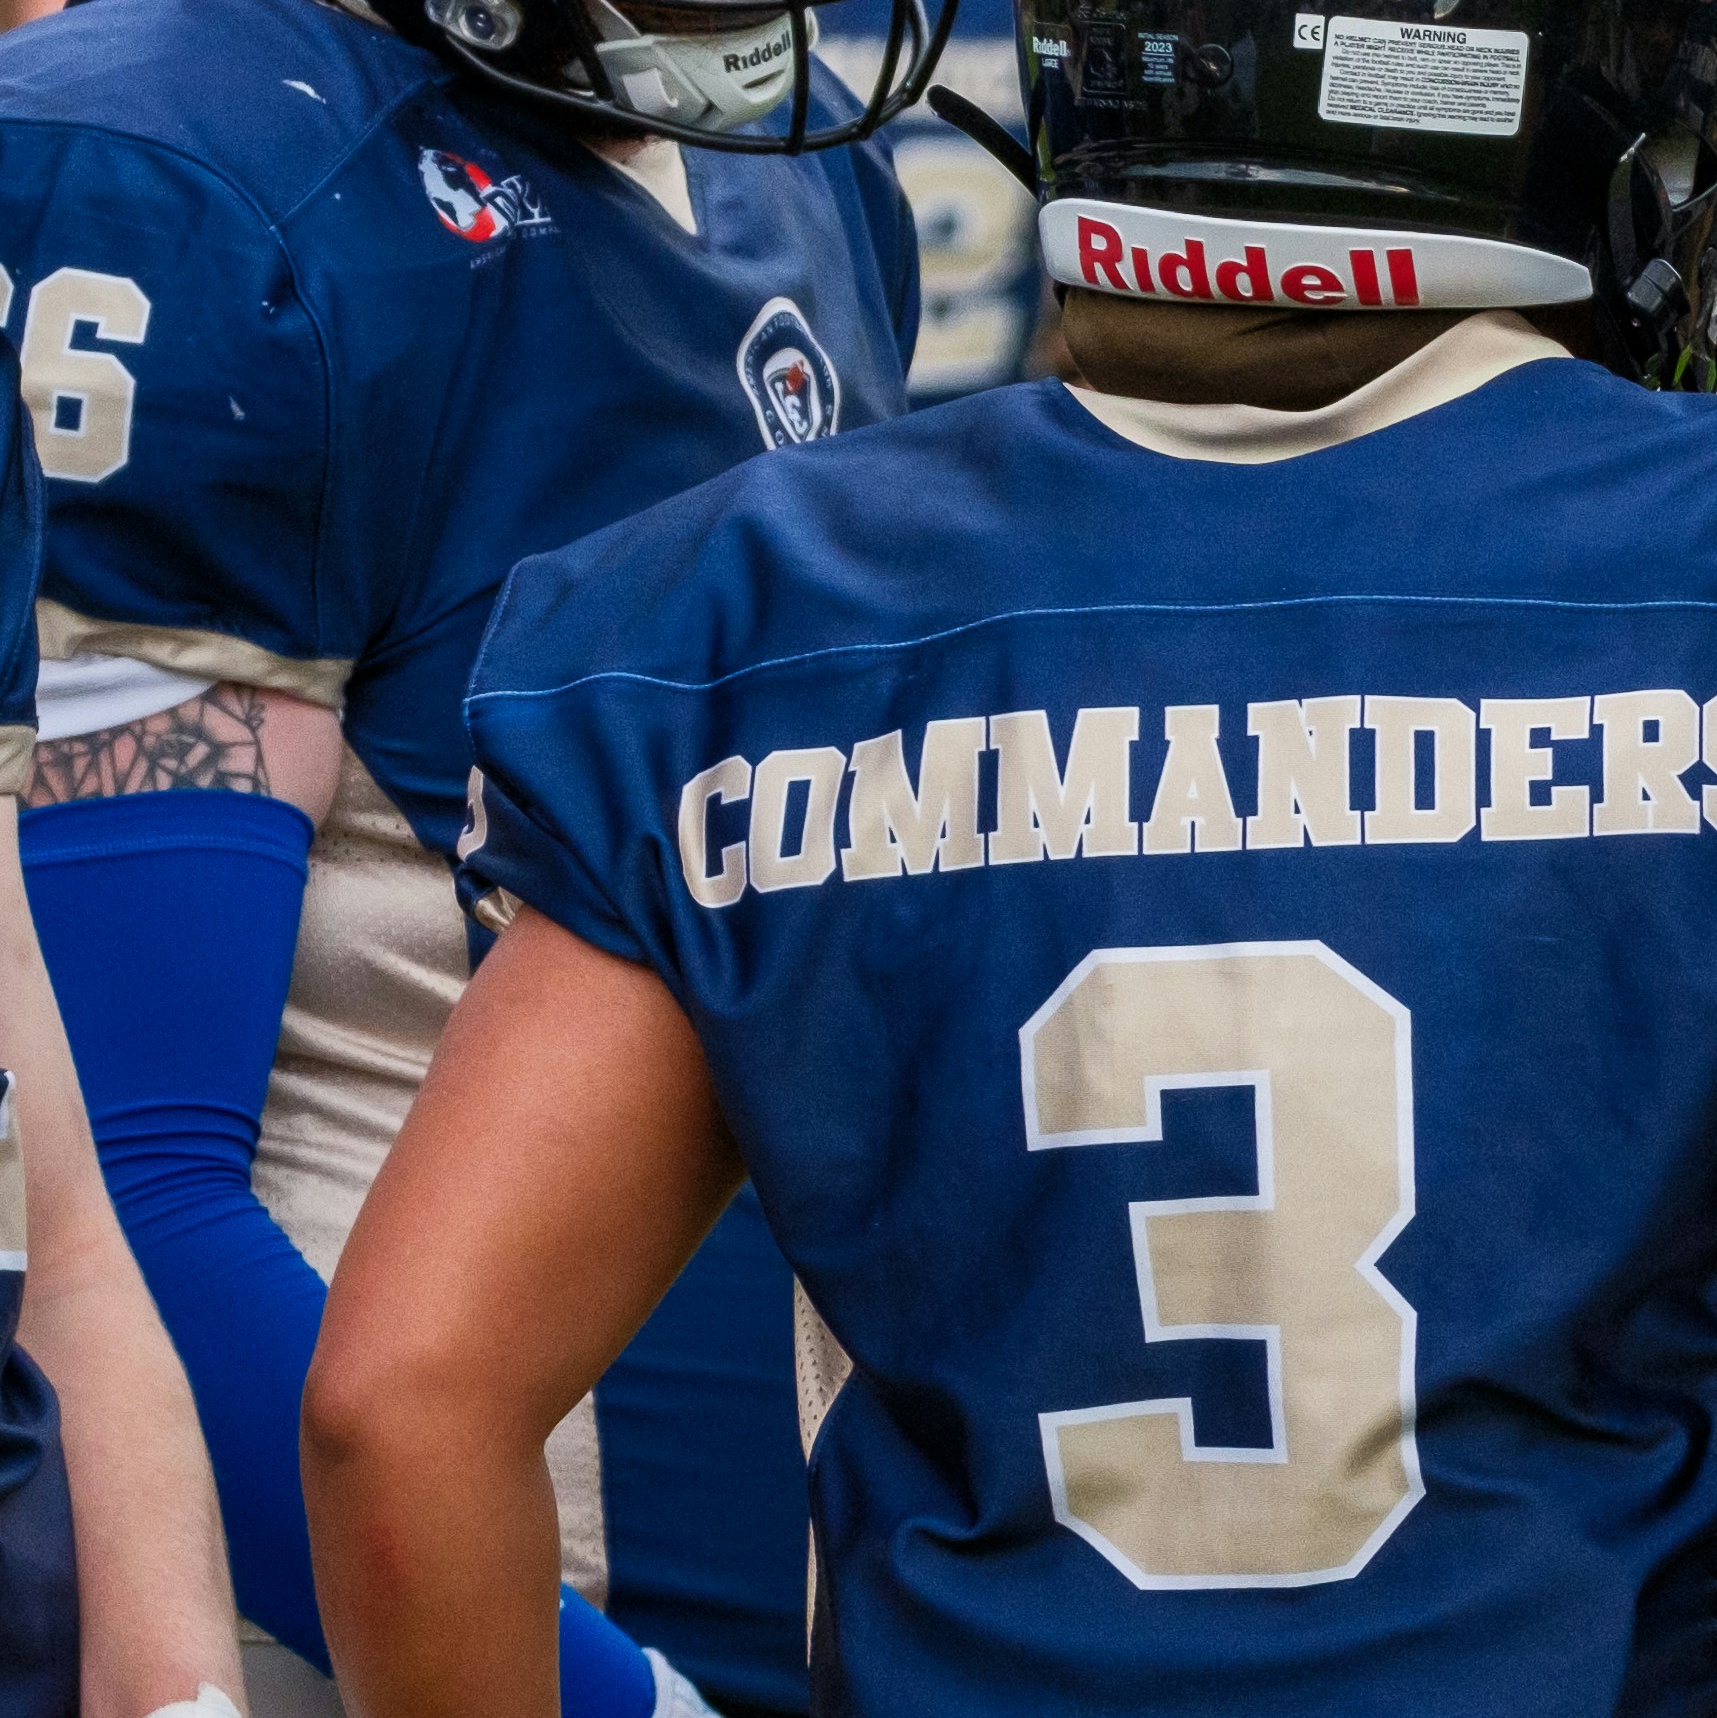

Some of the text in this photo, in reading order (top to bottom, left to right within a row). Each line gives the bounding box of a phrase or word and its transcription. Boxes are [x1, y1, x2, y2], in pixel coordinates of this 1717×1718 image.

[1144, 41, 1173, 53] 2023
[1297, 24, 1321, 41] CE
[1400, 27, 1467, 44] WARNING
[723, 32, 791, 73] Riddell
[1077, 214, 1420, 307] Riddell
[1018, 940, 1427, 1591] 3
